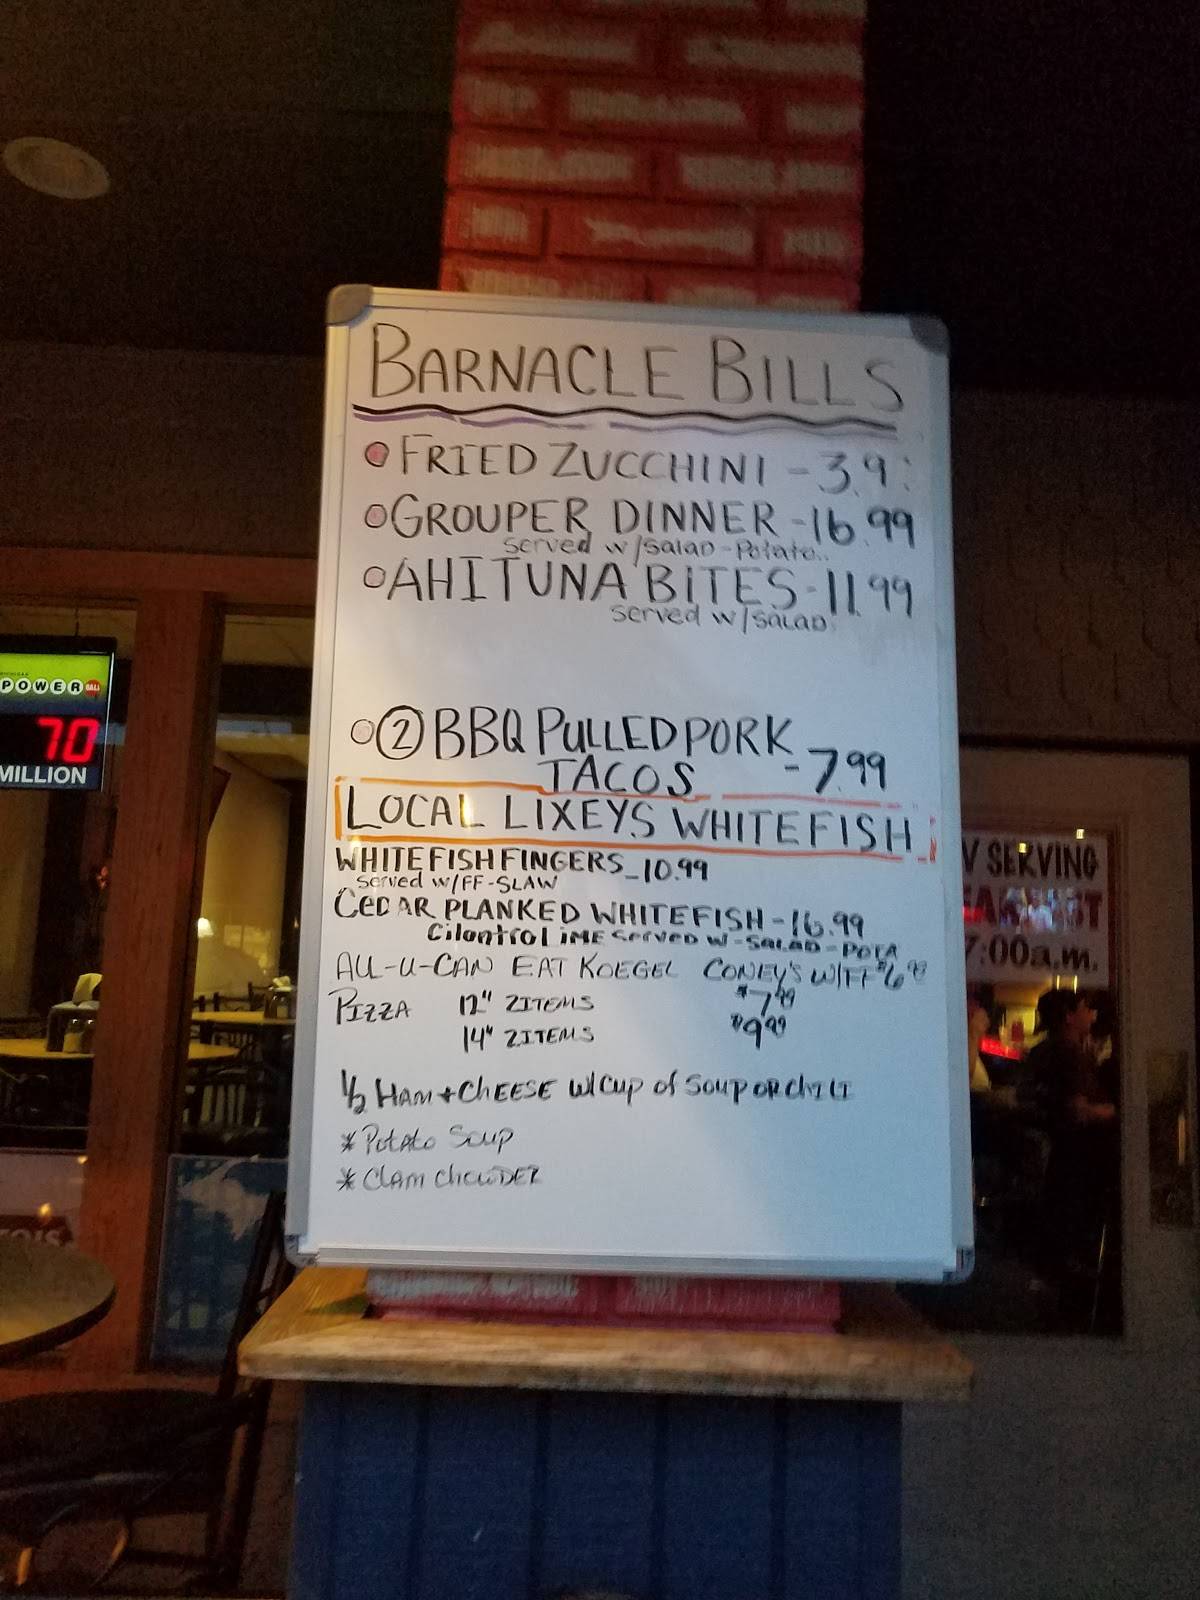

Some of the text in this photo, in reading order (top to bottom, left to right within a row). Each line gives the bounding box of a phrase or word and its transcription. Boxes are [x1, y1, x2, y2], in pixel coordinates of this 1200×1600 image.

[371, 322, 905, 413] BARNACLE BILLS
[401, 434, 537, 476] FRIED
[548, 442, 765, 487] ZUCCHINI
[391, 493, 592, 538] GROUPER
[613, 498, 779, 538] DINNER
[646, 563, 798, 611] BITES
[611, 604, 701, 627] served
[2, 680, 81, 694] POWER
[37, 716, 101, 764] 70
[435, 705, 526, 760] BBQ
[685, 714, 793, 757] PORK
[0, 764, 87, 784] MILLION
[536, 754, 696, 797] TACOS
[347, 785, 912, 852] LOCAL LIXEYS WHITEFISH
[356, 871, 423, 889] served
[444, 897, 581, 925] PLANKED
[590, 901, 764, 932] WHITEFISH
[511, 953, 569, 979] EAT
[579, 951, 679, 981] KOEGEL
[328, 987, 413, 1025] PIZZA
[653, 1069, 677, 1097] of
